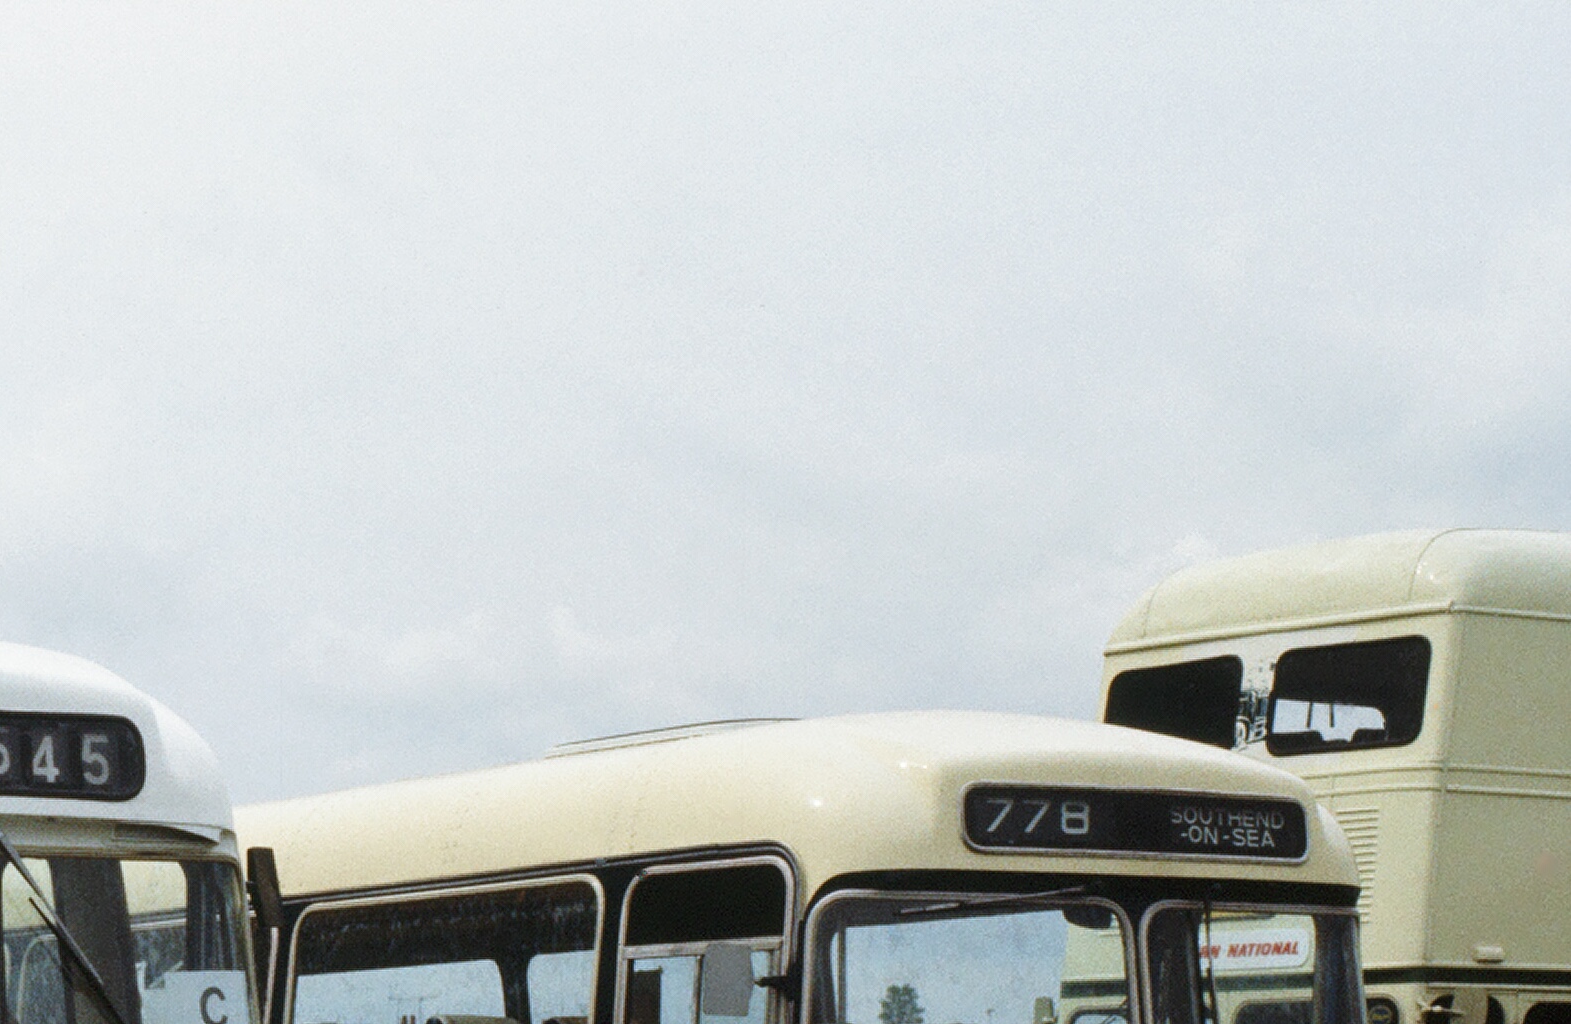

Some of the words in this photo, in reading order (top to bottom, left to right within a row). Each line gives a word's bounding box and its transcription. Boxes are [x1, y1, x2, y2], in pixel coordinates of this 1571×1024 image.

[986, 798, 1090, 835] 778
[1170, 805, 1286, 830] SOUTHEND
[1226, 940, 1299, 958] NATIONAL
